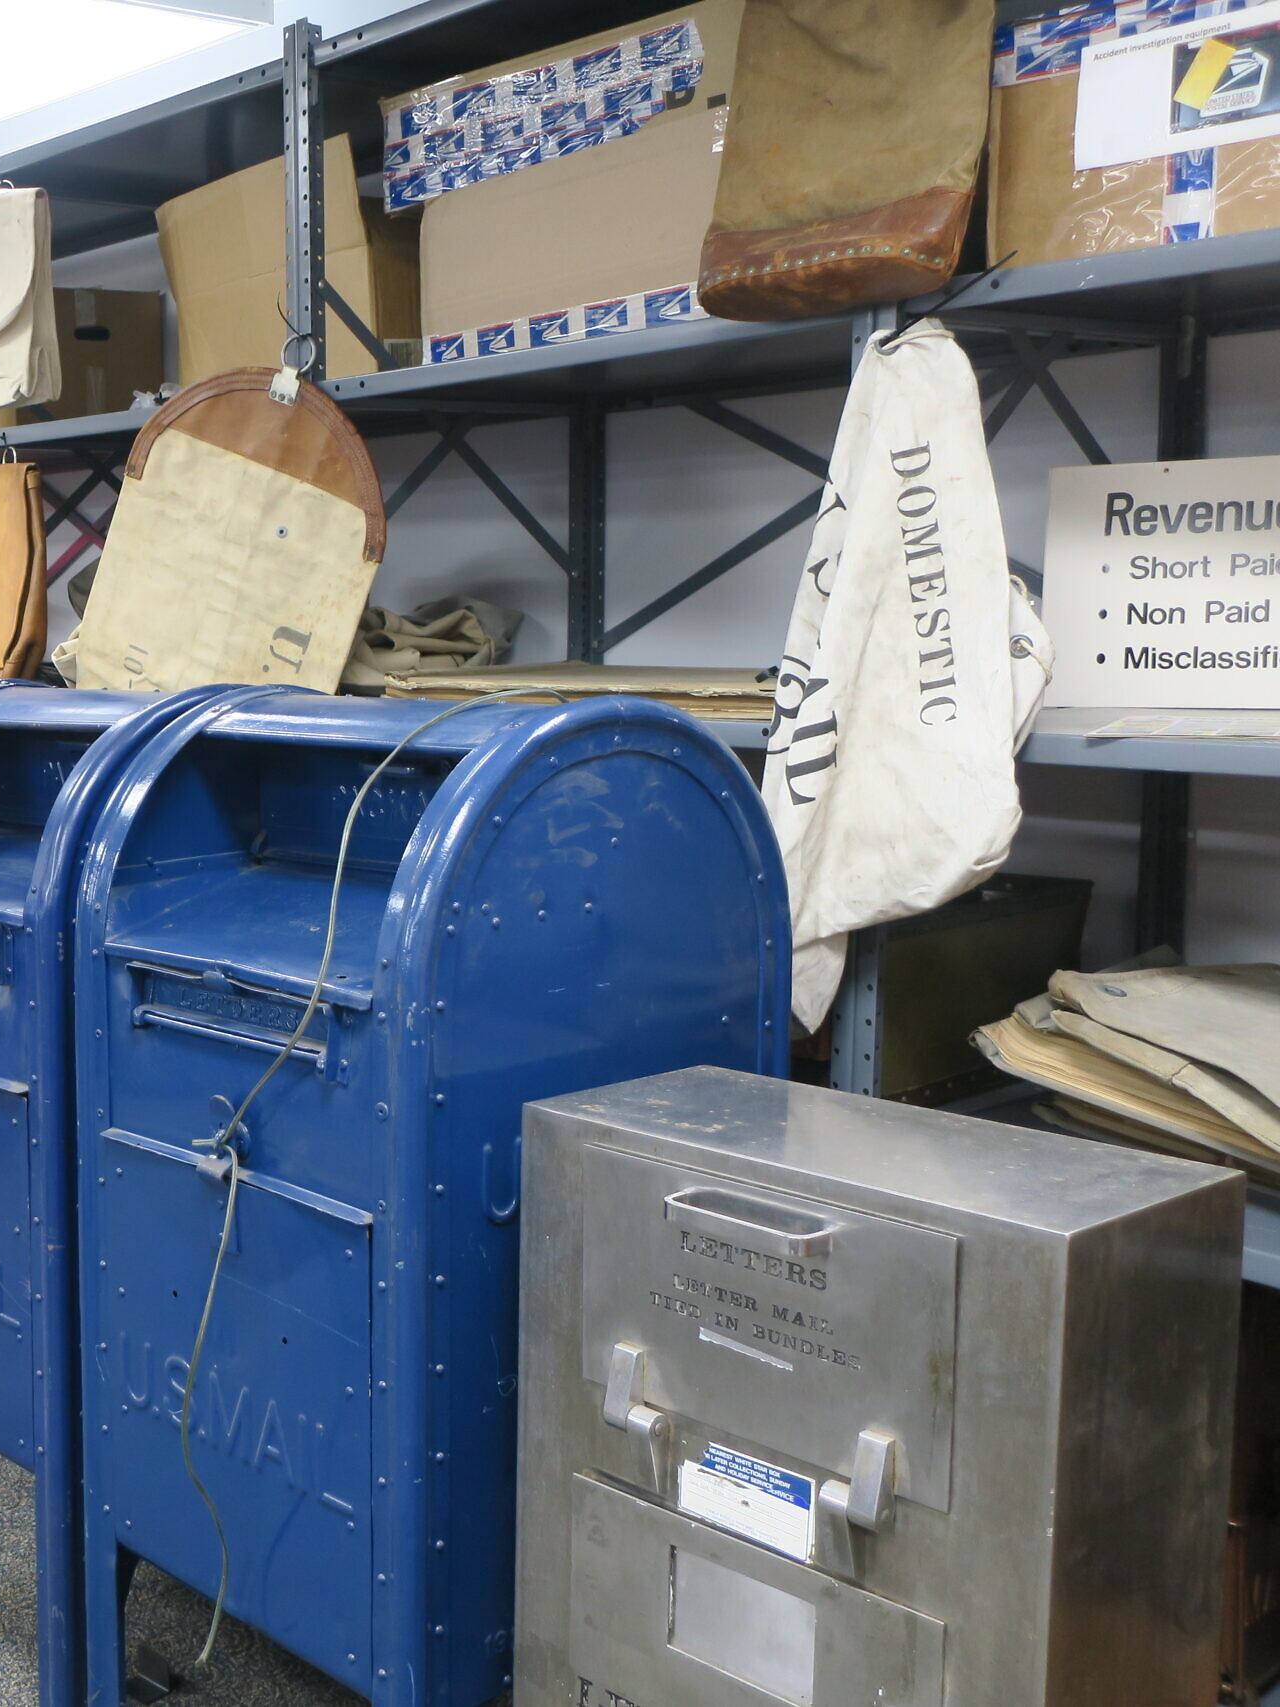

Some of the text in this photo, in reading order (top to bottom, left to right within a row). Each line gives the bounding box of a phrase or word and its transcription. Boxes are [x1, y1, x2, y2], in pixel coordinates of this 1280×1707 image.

[1093, 46, 1128, 62] Accident
[1129, 34, 1182, 54] investigation
[1184, 22, 1231, 42] equipment
[1104, 491, 1280, 537] Revenu
[889, 440, 959, 727] DOMESTIC
[1128, 552, 1280, 580] Short Pai
[1126, 599, 1270, 626] Non Paid
[1123, 645, 1280, 670] Misclassifi
[679, 1230, 829, 1291] LETTERS
[672, 1273, 835, 1336] LETTER MAIL
[648, 1290, 863, 1371] TIED IN BUNDLES
[711, 1455, 728, 1466] LATER
[769, 1477, 792, 1489] SUNDAY
[714, 1463, 774, 1490] AND HOLIDAY SERVICE
[734, 1456, 753, 1468] WHITE
[753, 1463, 768, 1473] STAR
[768, 1468, 781, 1479] BOX
